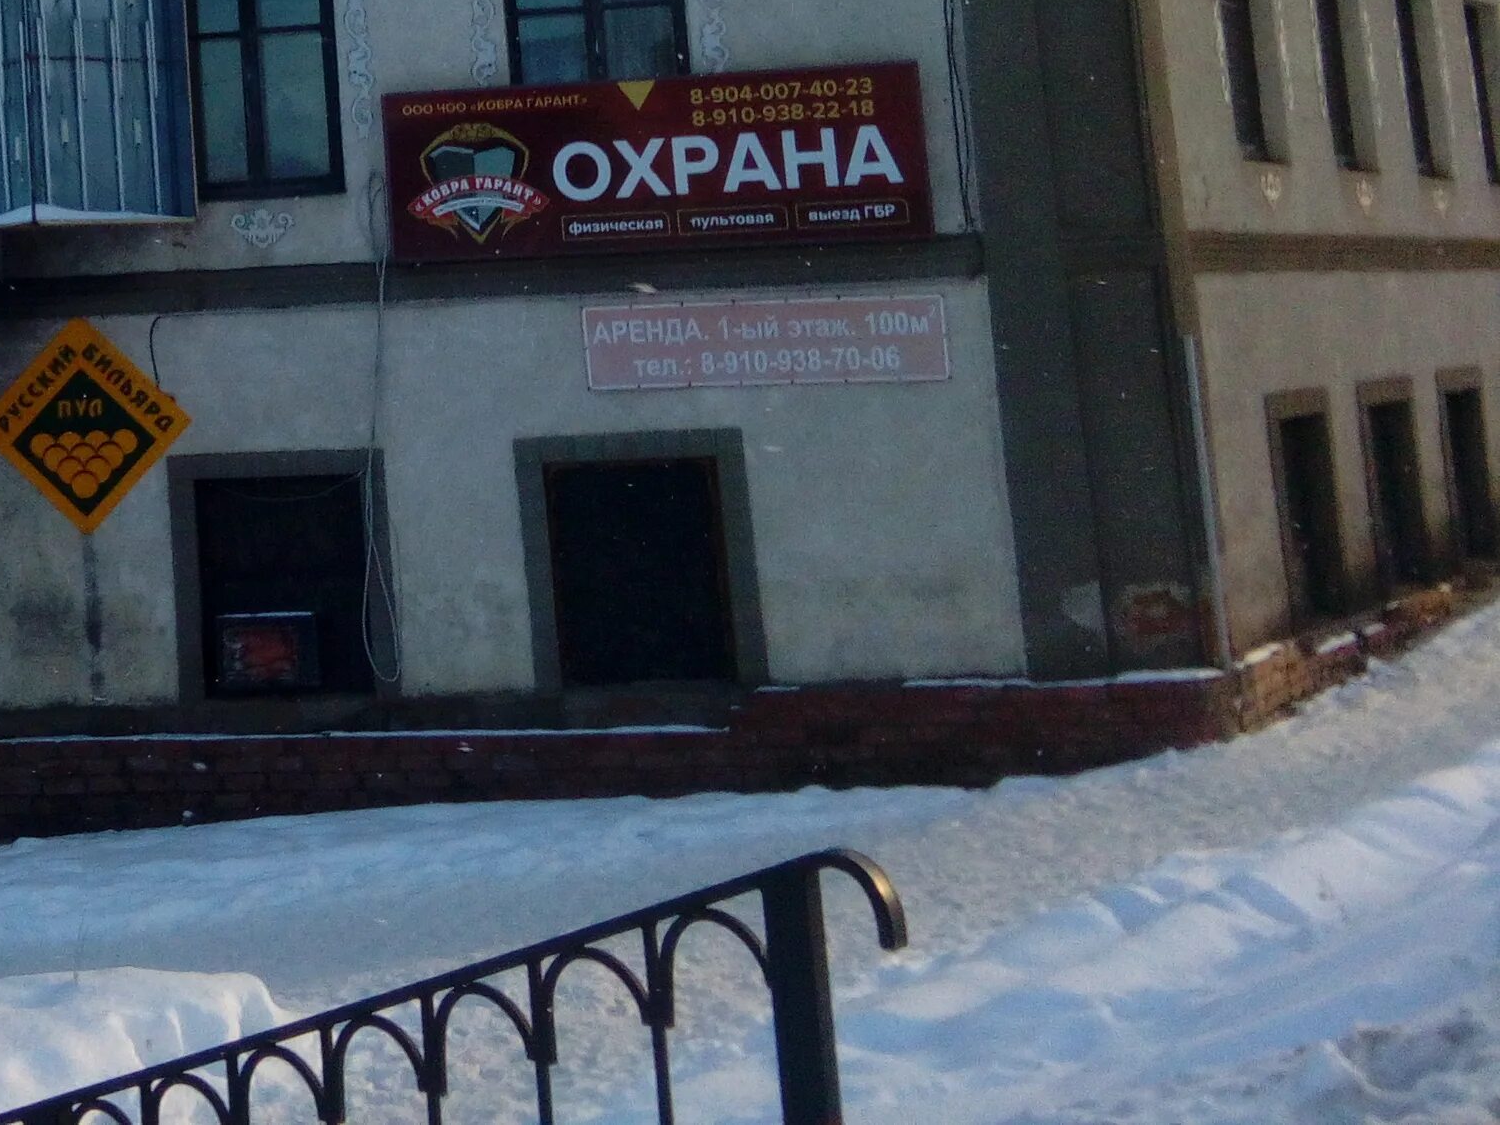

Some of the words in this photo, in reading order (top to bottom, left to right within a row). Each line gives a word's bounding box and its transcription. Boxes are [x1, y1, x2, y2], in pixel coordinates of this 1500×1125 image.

[690, 77, 873, 105] 8-904-007-40-23
[402, 103, 433, 116] ООО
[691, 99, 875, 127] 8-910-938-22-18
[552, 124, 905, 202] ОХРАНА
[690, 211, 775, 230] пультовая
[808, 207, 861, 223] выезд
[864, 204, 896, 219] ГБР
[568, 218, 664, 236] физическая
[593, 316, 710, 346] АРЕНДА.
[717, 314, 779, 341] 1-ый
[701, 345, 901, 376] 8-910-938-70-06
[57, 398, 104, 420] ПУЛ
